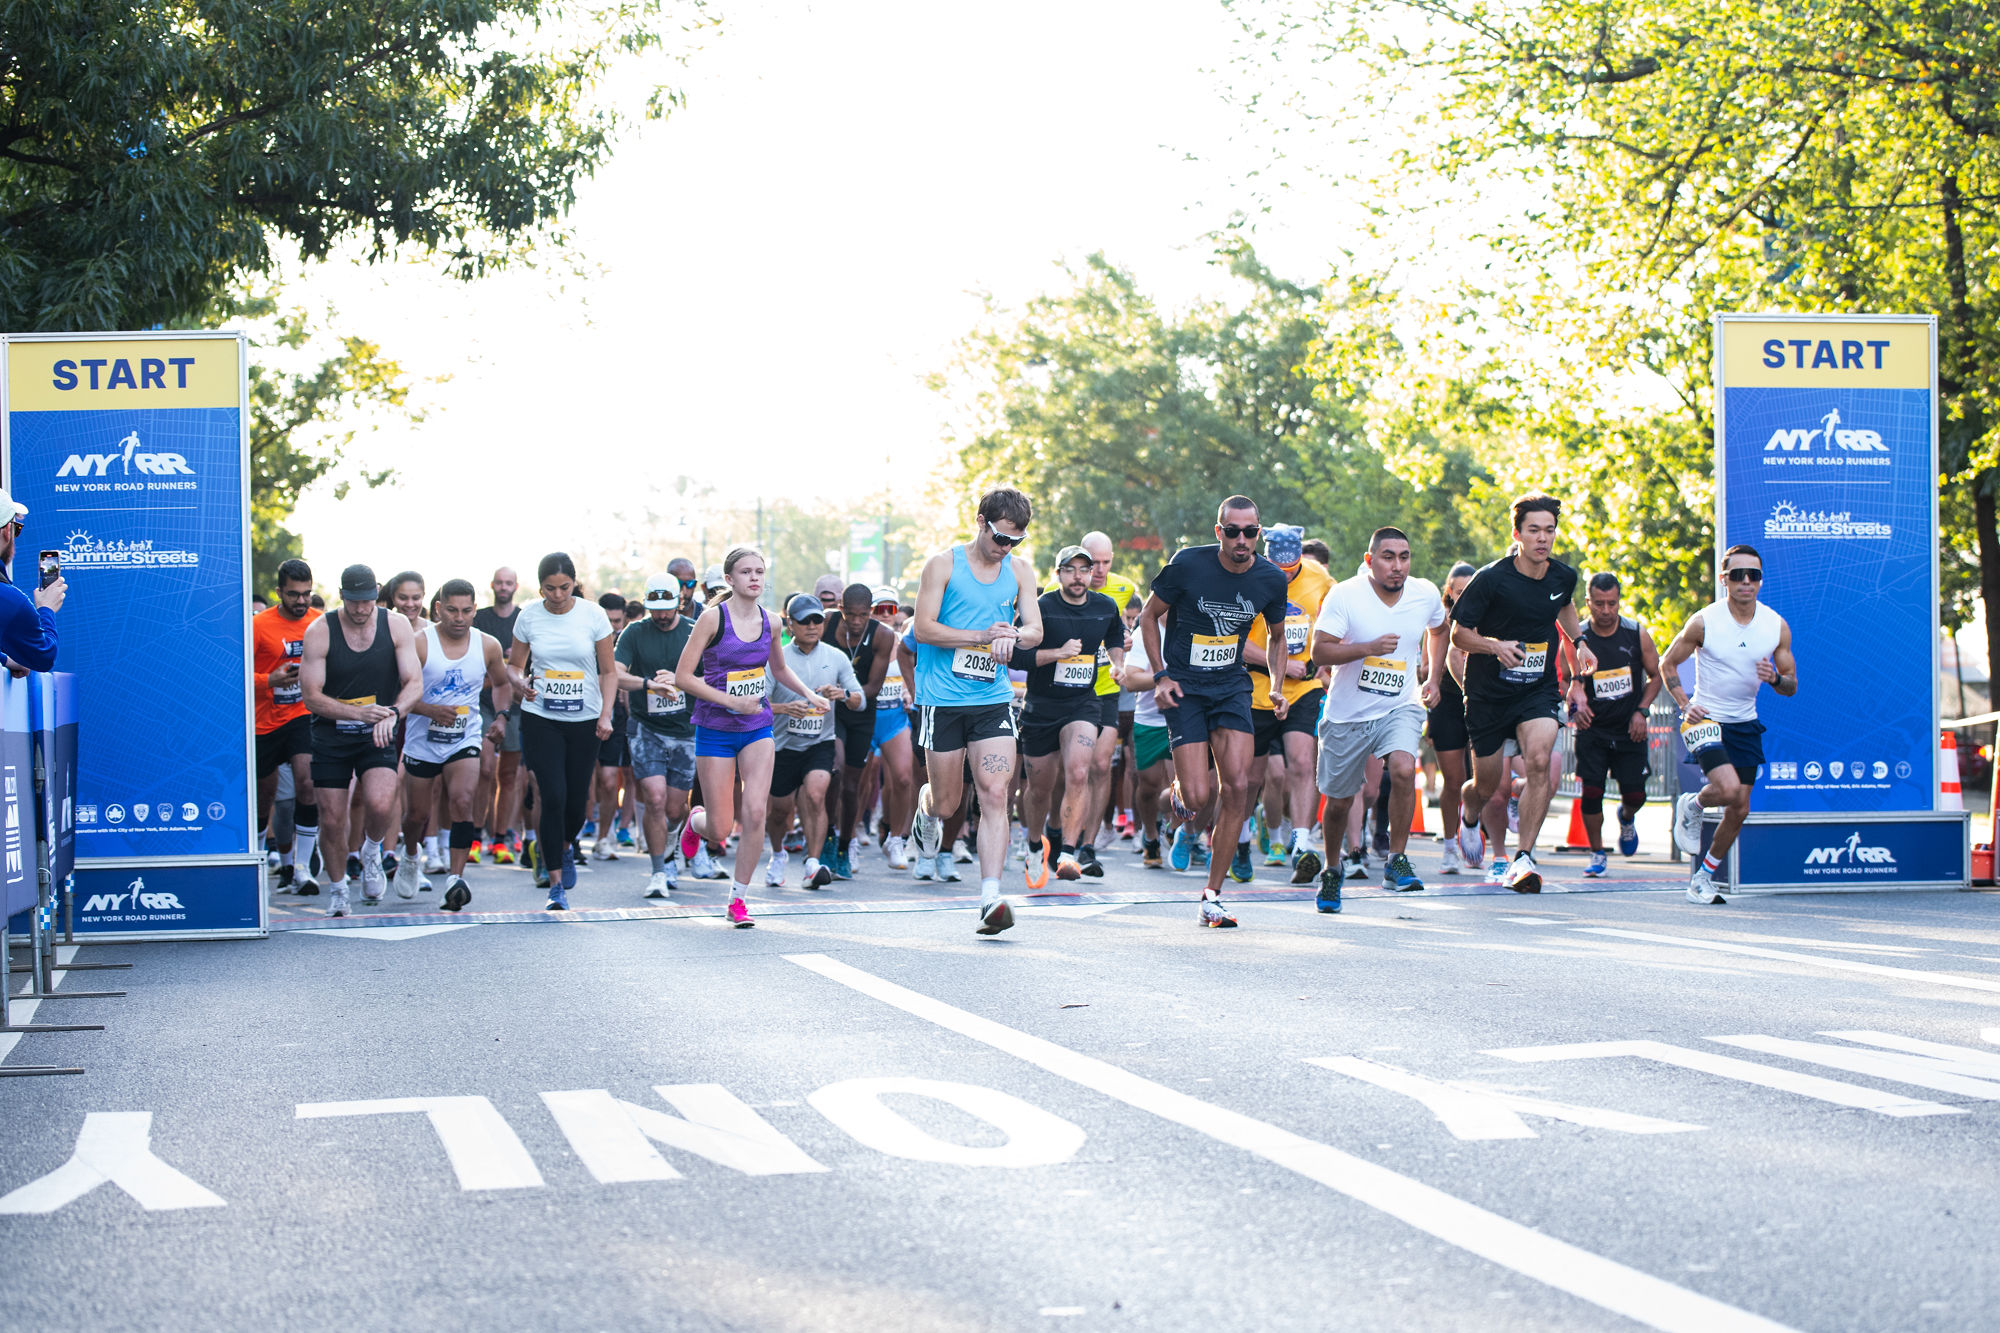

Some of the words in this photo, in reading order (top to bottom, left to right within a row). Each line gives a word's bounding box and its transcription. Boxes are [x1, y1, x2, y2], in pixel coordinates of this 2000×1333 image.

[1762, 339, 1890, 370] START
[52, 357, 195, 391] START
[1763, 457, 1786, 466] NEW
[1788, 457, 1814, 466] YORK
[1816, 457, 1844, 466] ROAD
[1846, 457, 1891, 466] RUNNERS
[55, 484, 80, 492] NEW
[82, 483, 111, 492] YORK
[114, 483, 144, 491] ROAD
[147, 481, 197, 491] RUNNERS
[1775, 514, 1796, 523] NYC
[69, 544, 93, 552] NYC
[1286, 627, 1308, 640] 0607
[1202, 647, 1236, 662] 21680
[1522, 655, 1545, 668] 1668
[964, 654, 996, 672] 20382
[1064, 667, 1092, 680] 20608
[545, 682, 583, 695] A20244
[729, 679, 765, 697] A20264
[1596, 677, 1631, 693] A20054
[789, 719, 823, 730] B20013
[1685, 725, 1720, 747] A20900
[1302, 1027, 2000, 1141] NLY
[0, 1076, 1088, 1214] ONLY
